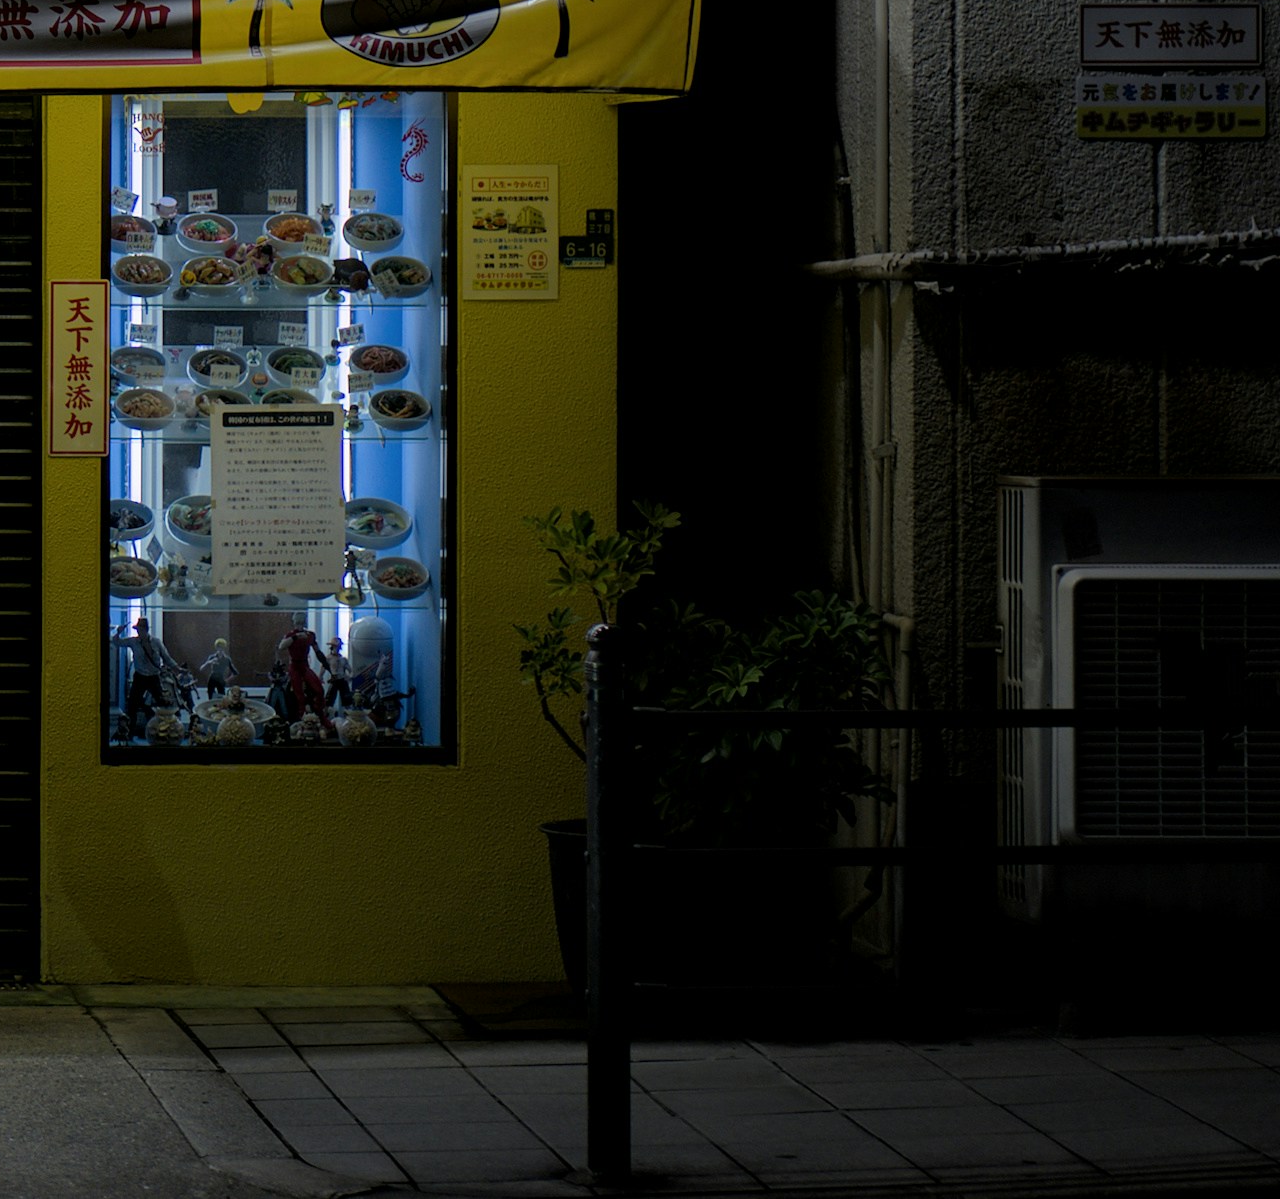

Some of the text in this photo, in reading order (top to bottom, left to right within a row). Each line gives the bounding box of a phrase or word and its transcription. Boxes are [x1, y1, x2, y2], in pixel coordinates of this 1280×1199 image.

[350, 28, 475, 63] KIMUCHI
[1096, 20, 1246, 48] 天下無添加
[1082, 111, 1262, 133] キムチギャラリー
[566, 242, 607, 257] 6-16
[65, 297, 94, 439] 天下無添加
